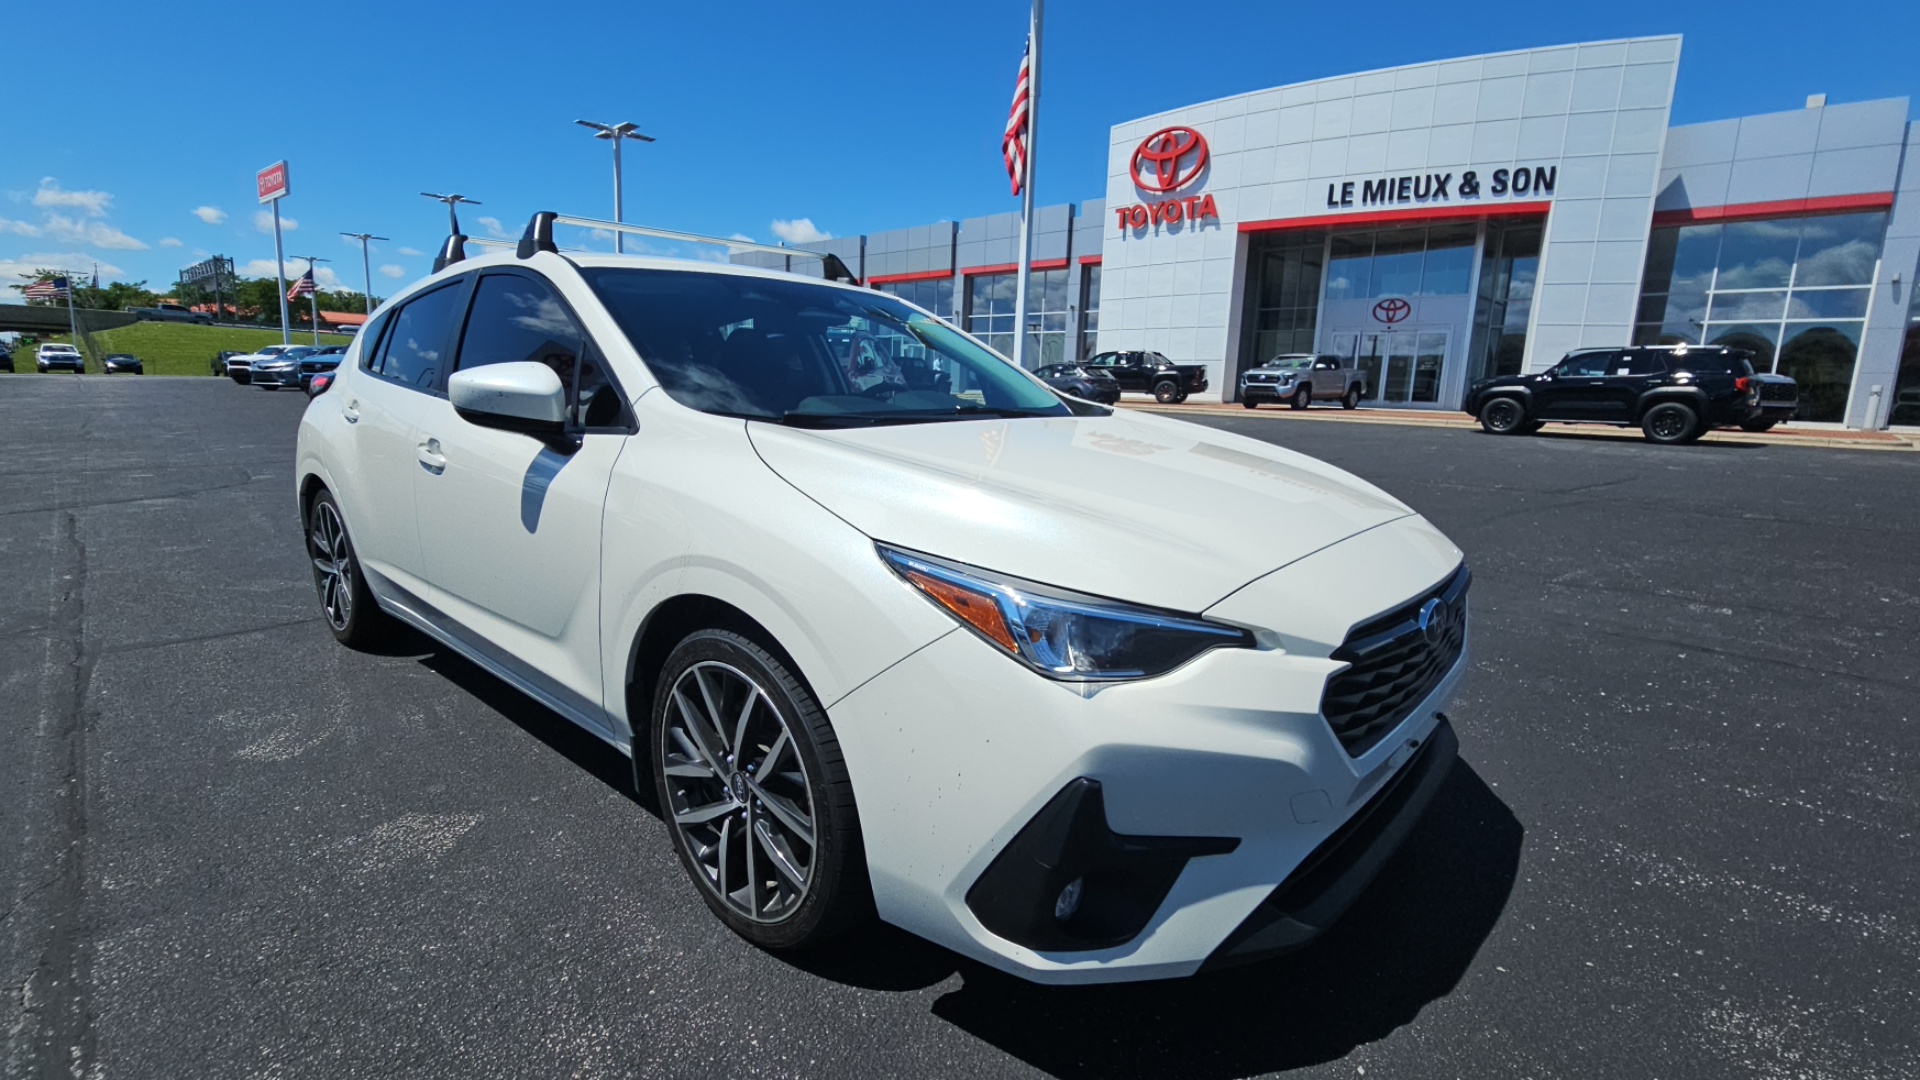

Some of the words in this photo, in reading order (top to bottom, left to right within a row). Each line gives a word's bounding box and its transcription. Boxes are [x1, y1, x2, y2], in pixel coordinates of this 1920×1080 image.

[1327, 182, 1354, 206] LE
[1362, 173, 1451, 205] MIEUX
[1458, 171, 1480, 196] &
[1491, 165, 1557, 196] SON
[1115, 194, 1218, 230] TOYOTA
